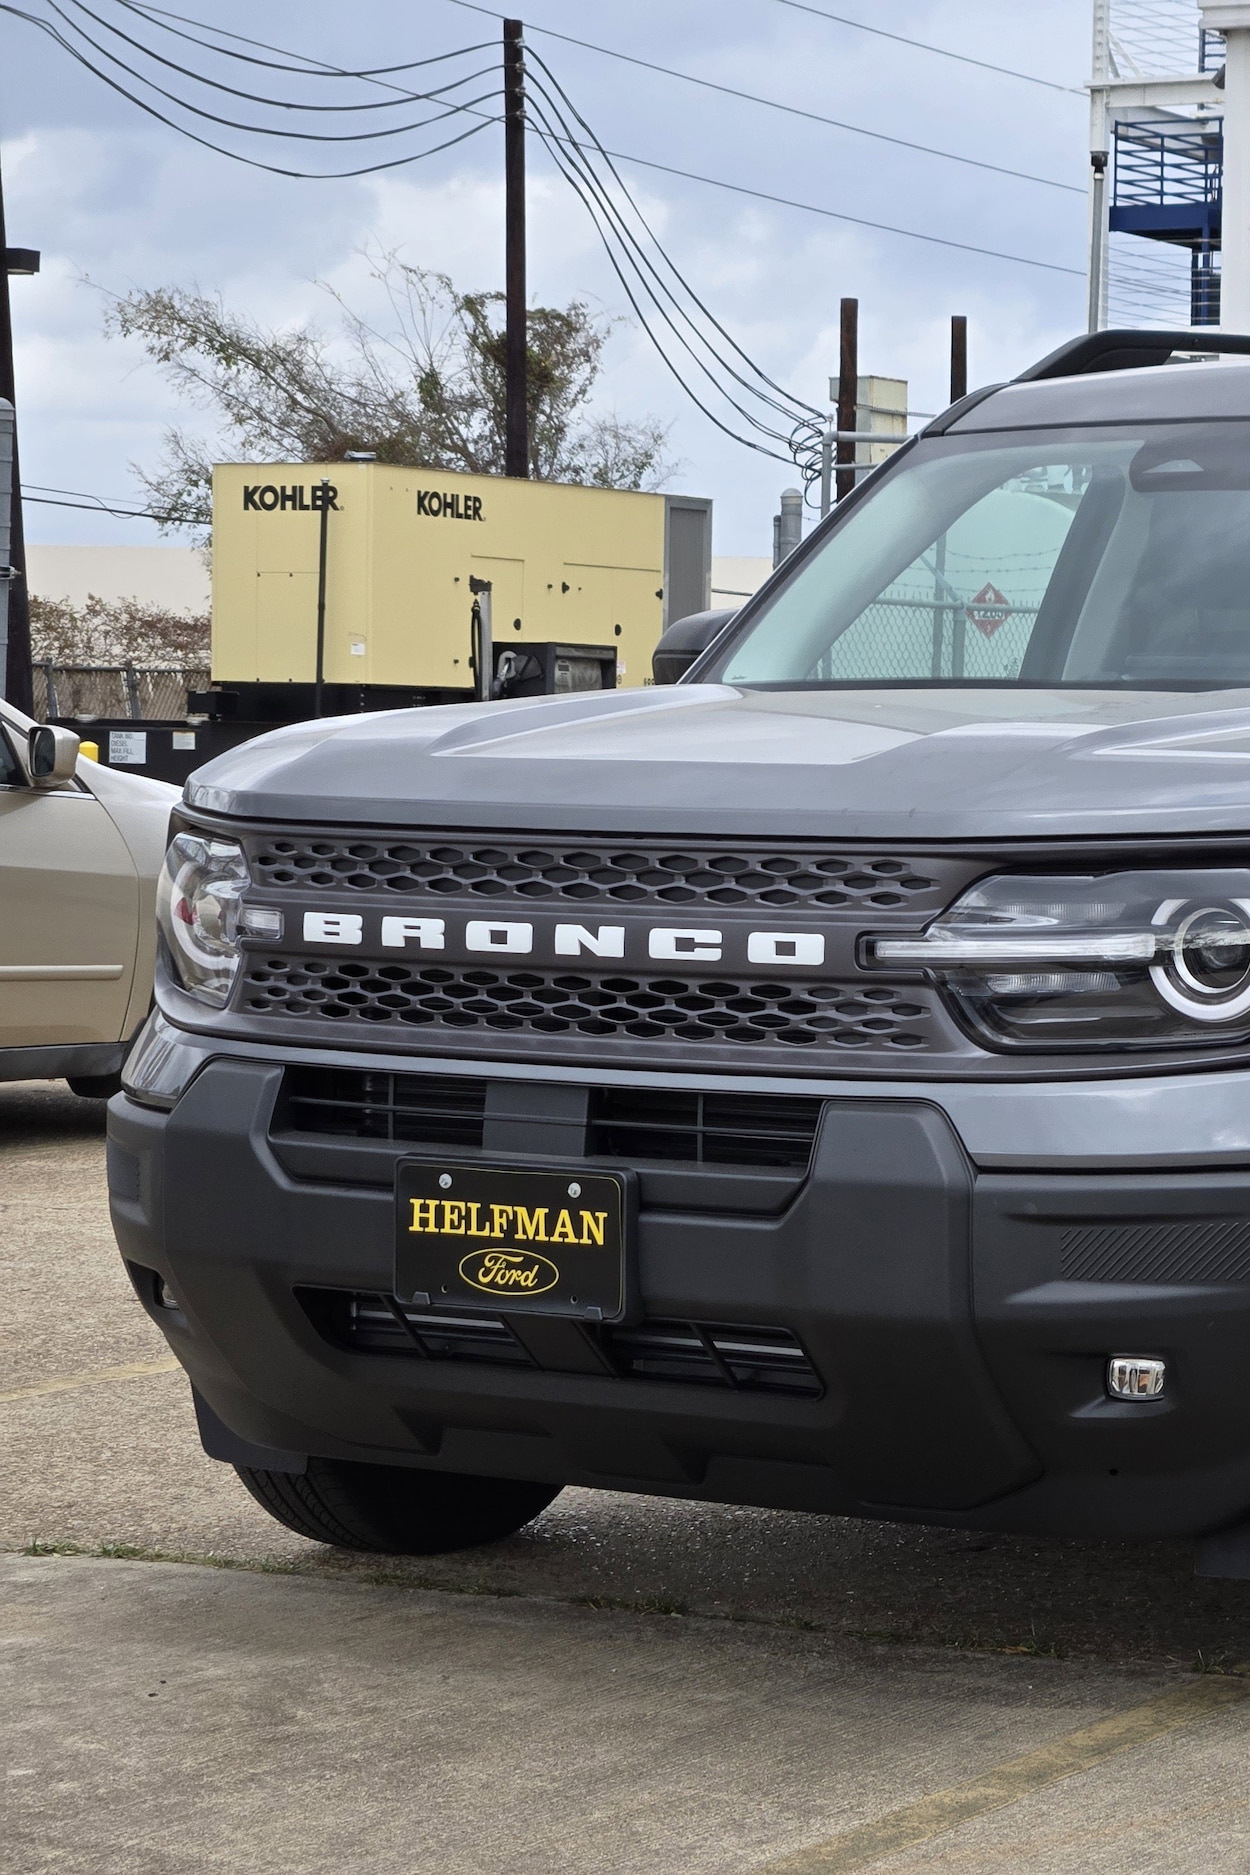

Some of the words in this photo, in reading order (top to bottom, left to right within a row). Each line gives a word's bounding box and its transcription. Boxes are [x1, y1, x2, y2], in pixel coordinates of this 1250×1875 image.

[243, 485, 340, 511] KOHLER
[416, 490, 484, 521] KOHLER
[303, 911, 825, 966] BRONCO
[408, 1198, 608, 1246] HELFMAN
[478, 1253, 539, 1287] Ford
